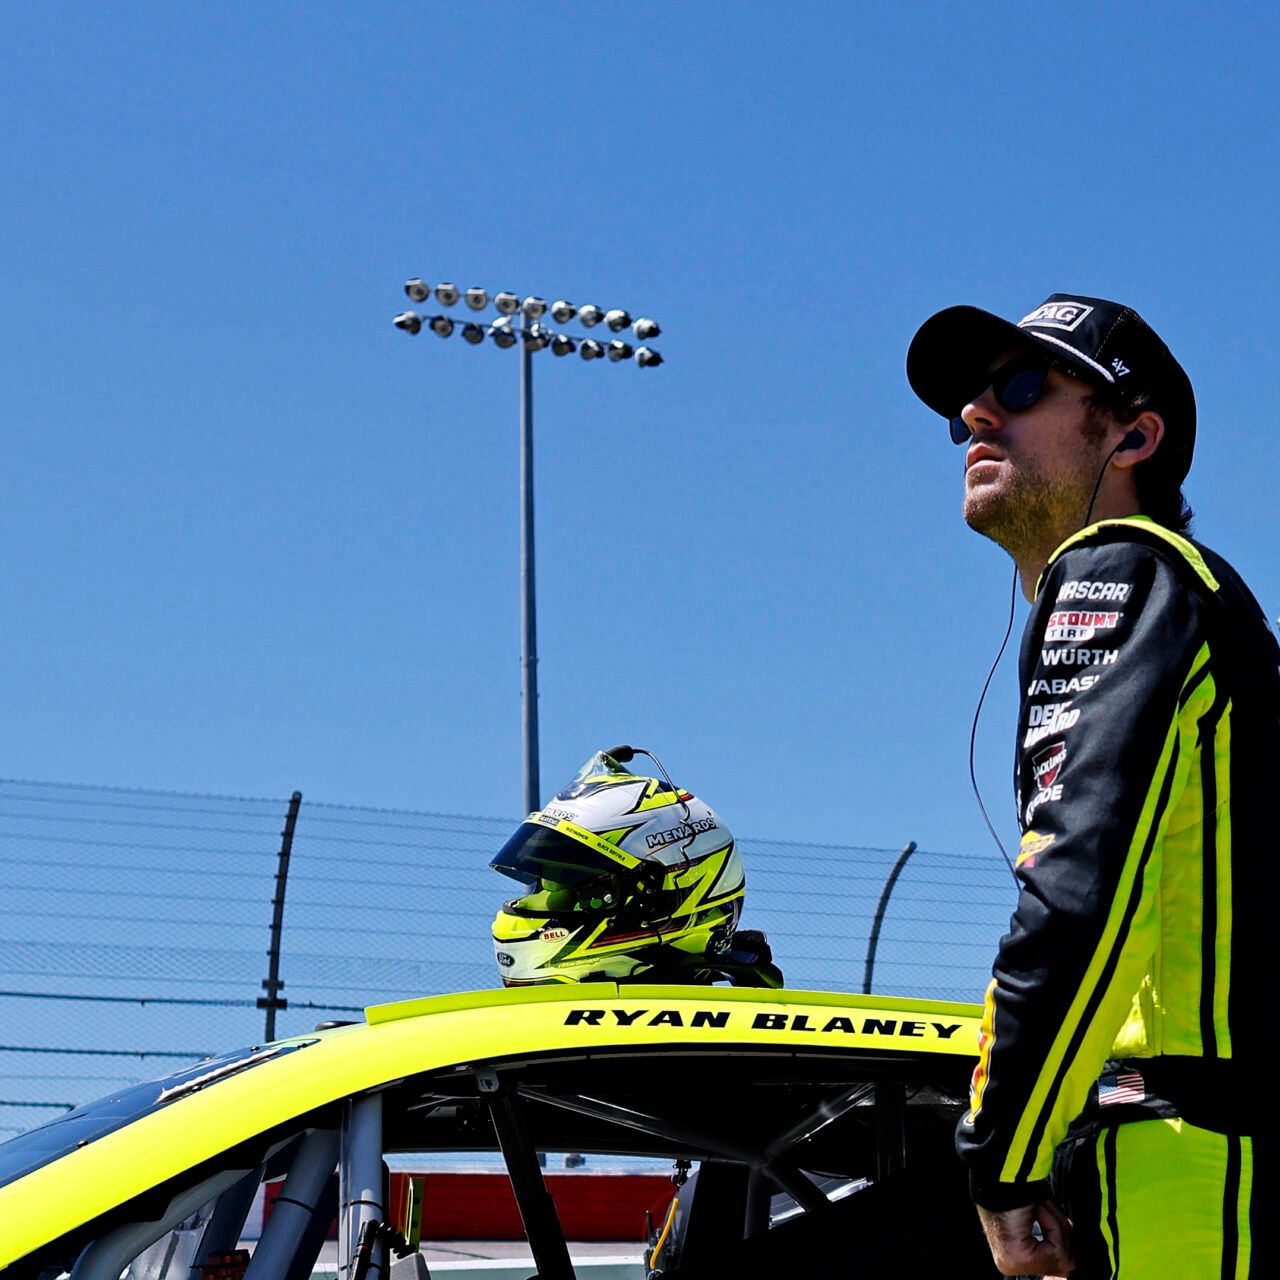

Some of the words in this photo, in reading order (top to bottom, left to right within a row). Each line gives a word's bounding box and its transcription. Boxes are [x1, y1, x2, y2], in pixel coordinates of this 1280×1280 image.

[1048, 612, 1118, 628] SCOUNT
[1050, 628, 1089, 638] TIRE
[1041, 649, 1119, 666] WÜRTH
[646, 817, 716, 849] MENARDS
[544, 931, 566, 940] BELL
[564, 1009, 730, 1028] RYAN
[752, 1013, 963, 1039] BLANEY
